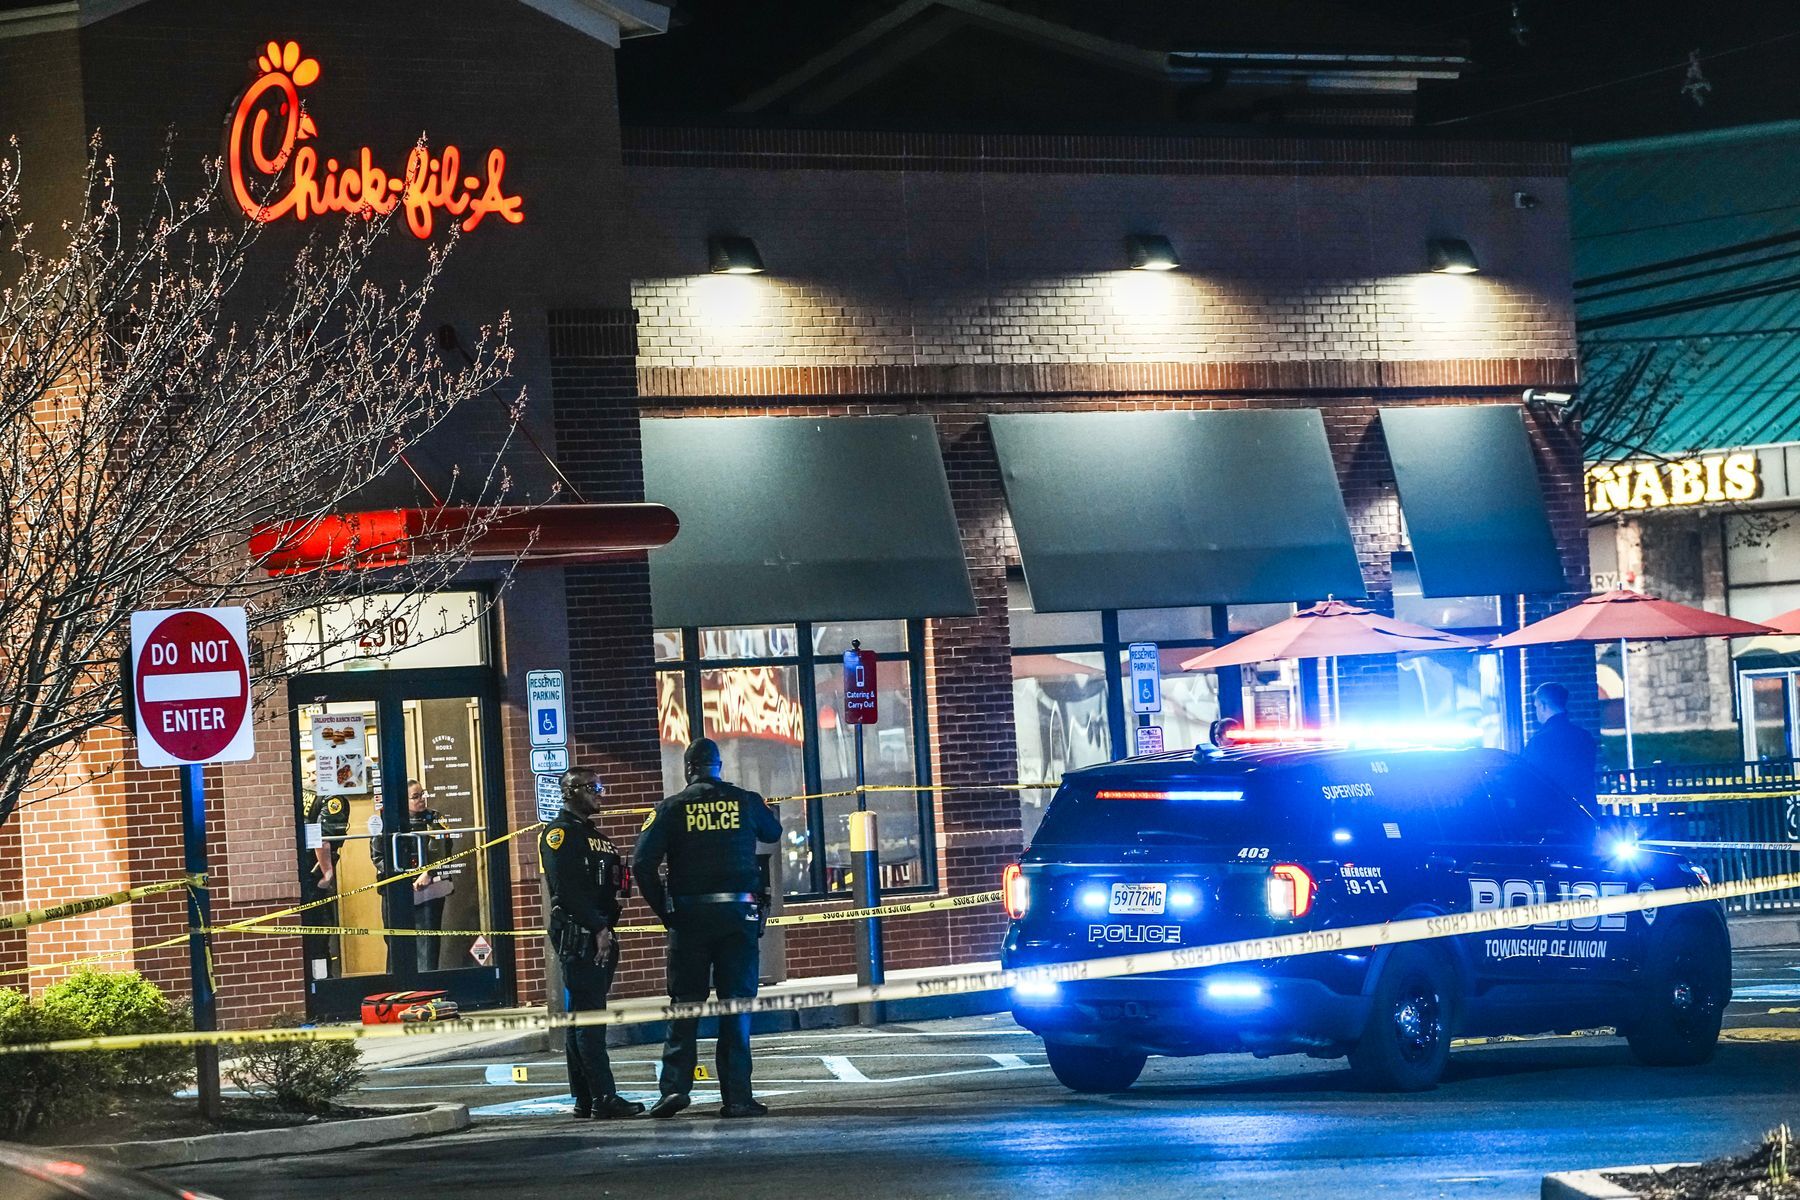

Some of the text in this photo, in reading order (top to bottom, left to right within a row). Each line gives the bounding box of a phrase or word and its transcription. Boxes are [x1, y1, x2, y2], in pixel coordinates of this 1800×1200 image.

[230, 72, 524, 239] Chick-fil-A
[1584, 454, 1757, 512] NABIS
[358, 618, 408, 648] 2319
[151, 640, 229, 666] DO NOT
[1133, 662, 1156, 671] PARKING
[530, 678, 560, 688] RESERVED
[533, 690, 560, 700] PARKING
[848, 701, 863, 709] Carry
[162, 708, 226, 733] ENTER
[1370, 761, 1389, 774] 403
[1322, 783, 1375, 800] SUPERVISOR
[685, 800, 739, 815] UNION
[686, 811, 740, 832] POLICE
[1237, 847, 1270, 859] 403
[1340, 867, 1381, 878] EMERGENCY
[1350, 879, 1388, 894] 9-1-1
[94, 896, 113, 910] POLICE
[1114, 890, 1162, 906] 59772MG
[1468, 878, 1628, 932] POLICE
[45, 907, 63, 920] CROSS
[1427, 898, 1600, 935] POLICE LINE DO NOT CROSS
[1088, 924, 1181, 943] POLICE
[1172, 931, 1342, 967] POLICE LINE DO NOT CROSS
[1485, 939, 1607, 958] TOWNSHIP OF UNION
[992, 971, 1007, 988] DO
[1046, 963, 1088, 982] POLICE
[917, 977, 958, 995] CROSS
[964, 974, 986, 990] NOT
[516, 1070, 522, 1078] 1
[697, 1067, 704, 1077] 2
